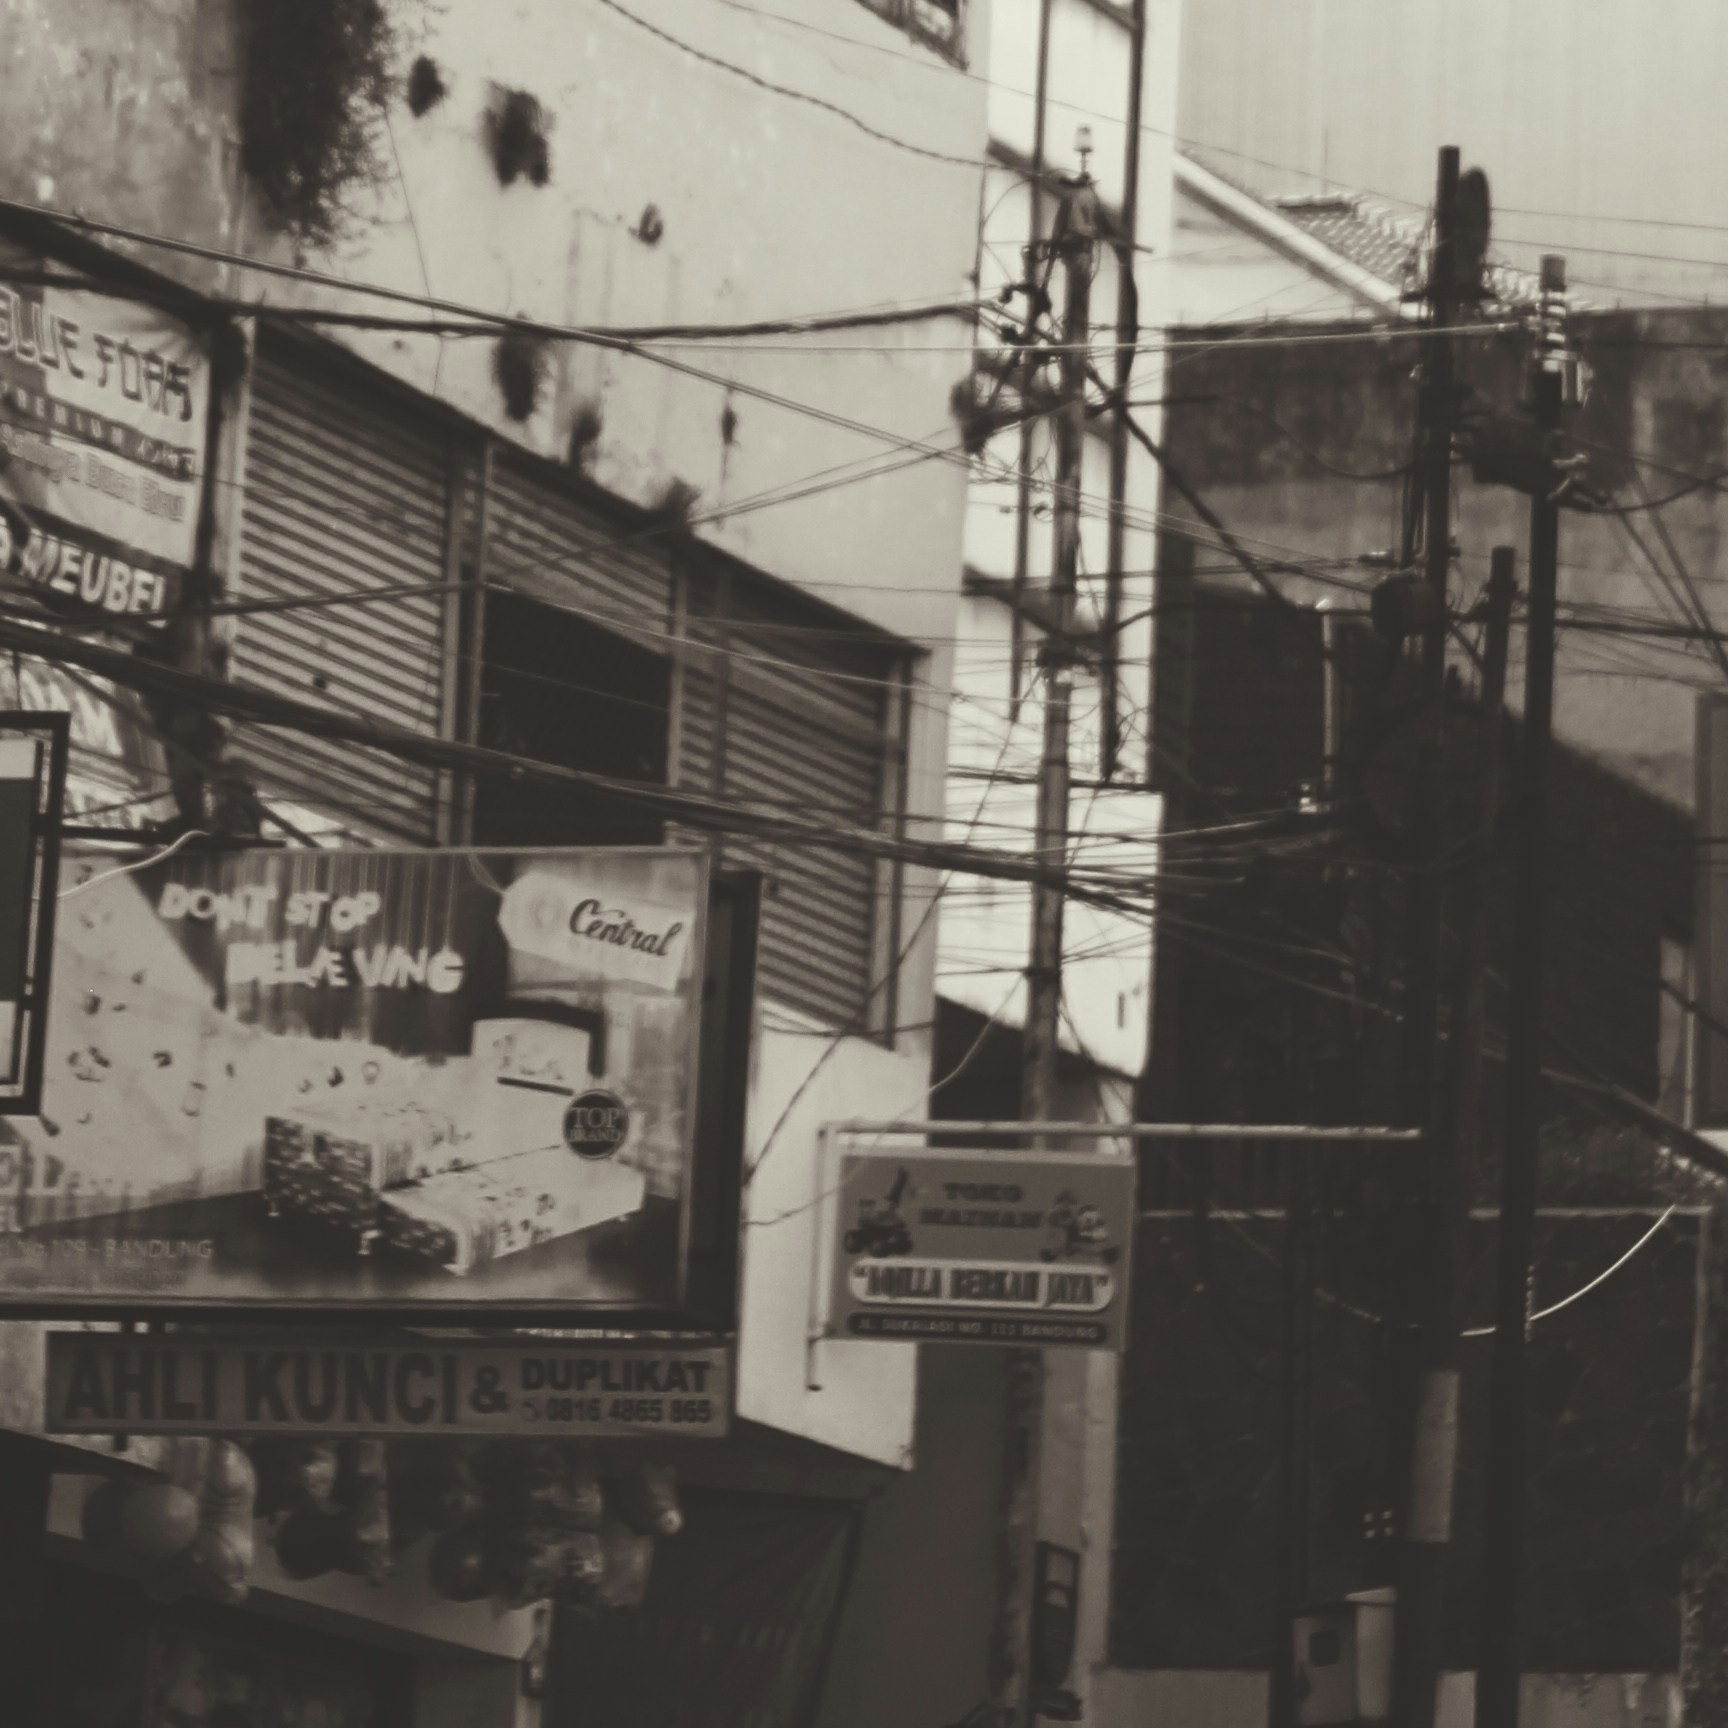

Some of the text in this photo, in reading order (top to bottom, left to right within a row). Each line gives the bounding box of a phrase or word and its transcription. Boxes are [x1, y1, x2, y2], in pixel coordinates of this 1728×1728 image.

[569, 899, 683, 956] Central
[573, 1107, 620, 1128] TOP
[569, 1128, 621, 1143] BRAND
[66, 1350, 508, 1424] AHLI KUNCI &
[521, 1358, 710, 1393] DUPLIKAT
